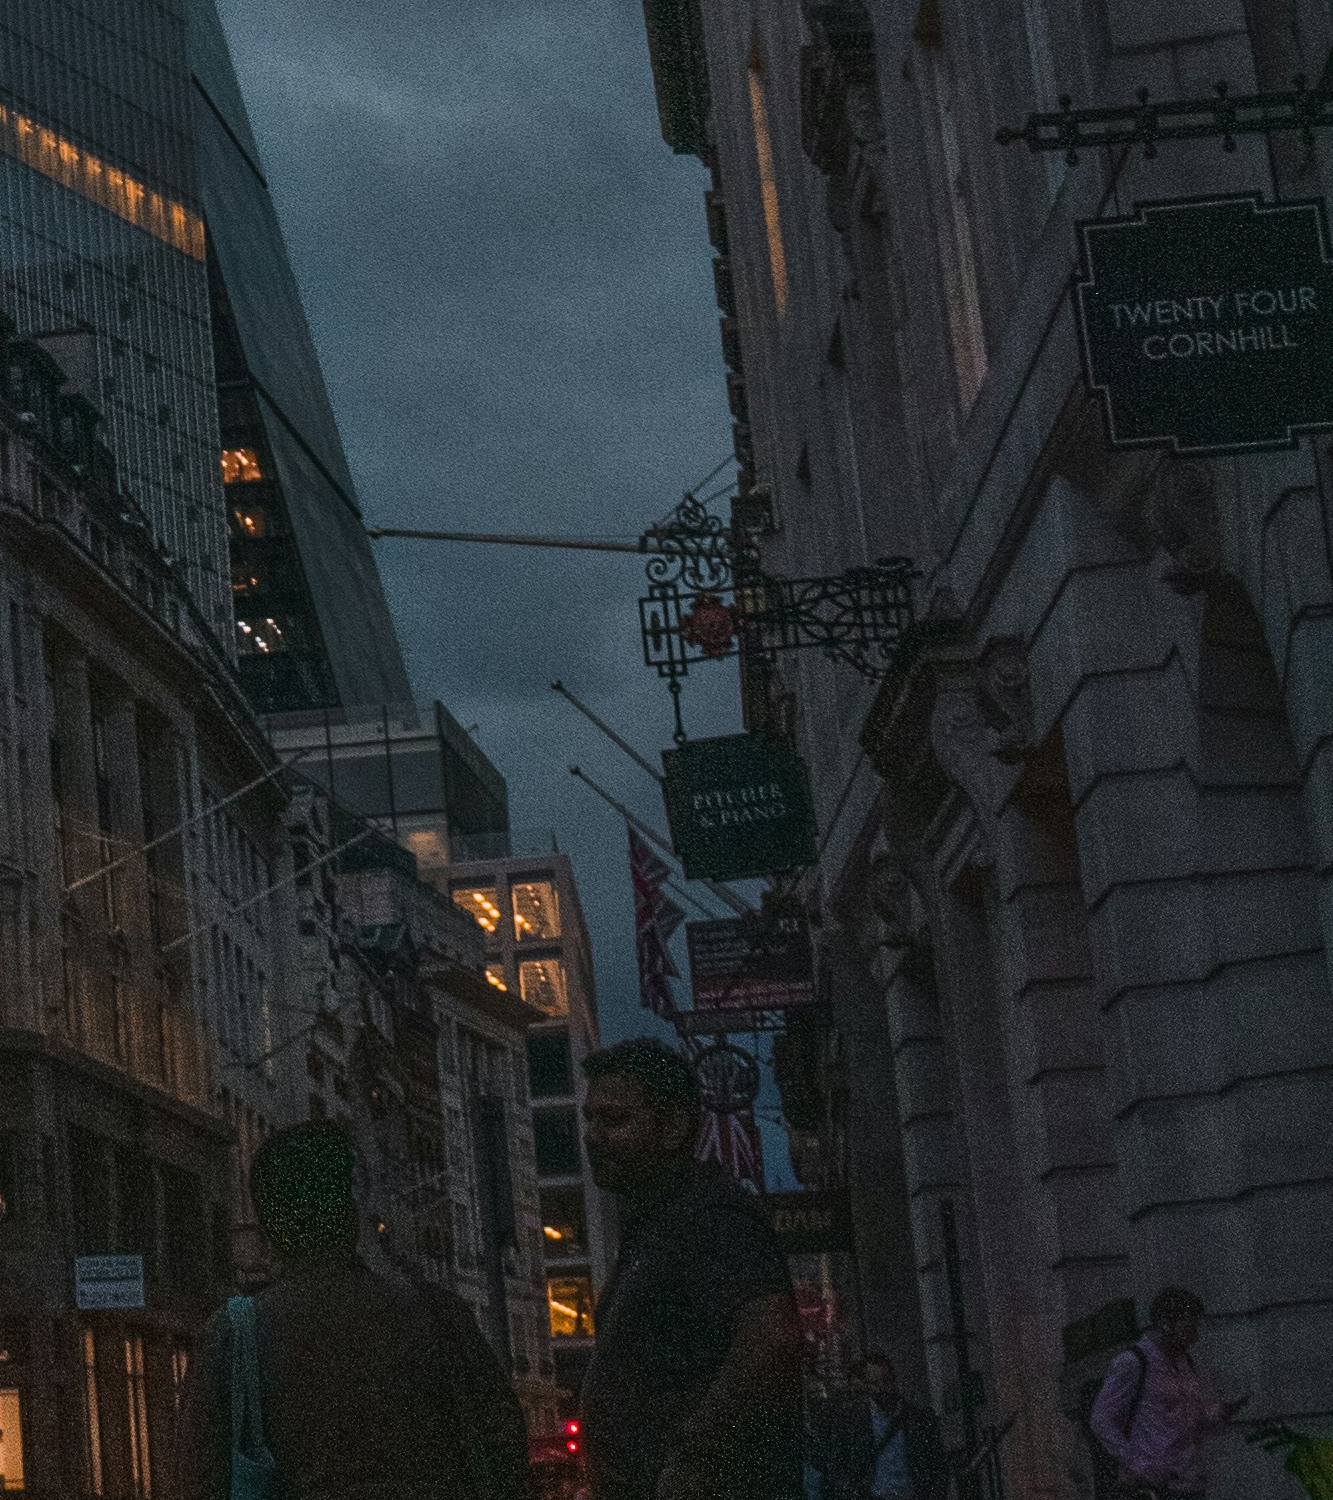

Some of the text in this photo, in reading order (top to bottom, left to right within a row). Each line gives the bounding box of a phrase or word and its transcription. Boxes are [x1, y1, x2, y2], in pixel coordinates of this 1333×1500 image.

[1109, 285, 1319, 329] TWENTY FOUR
[1141, 324, 1299, 361] CORNHILL
[720, 802, 787, 827] PIANO
